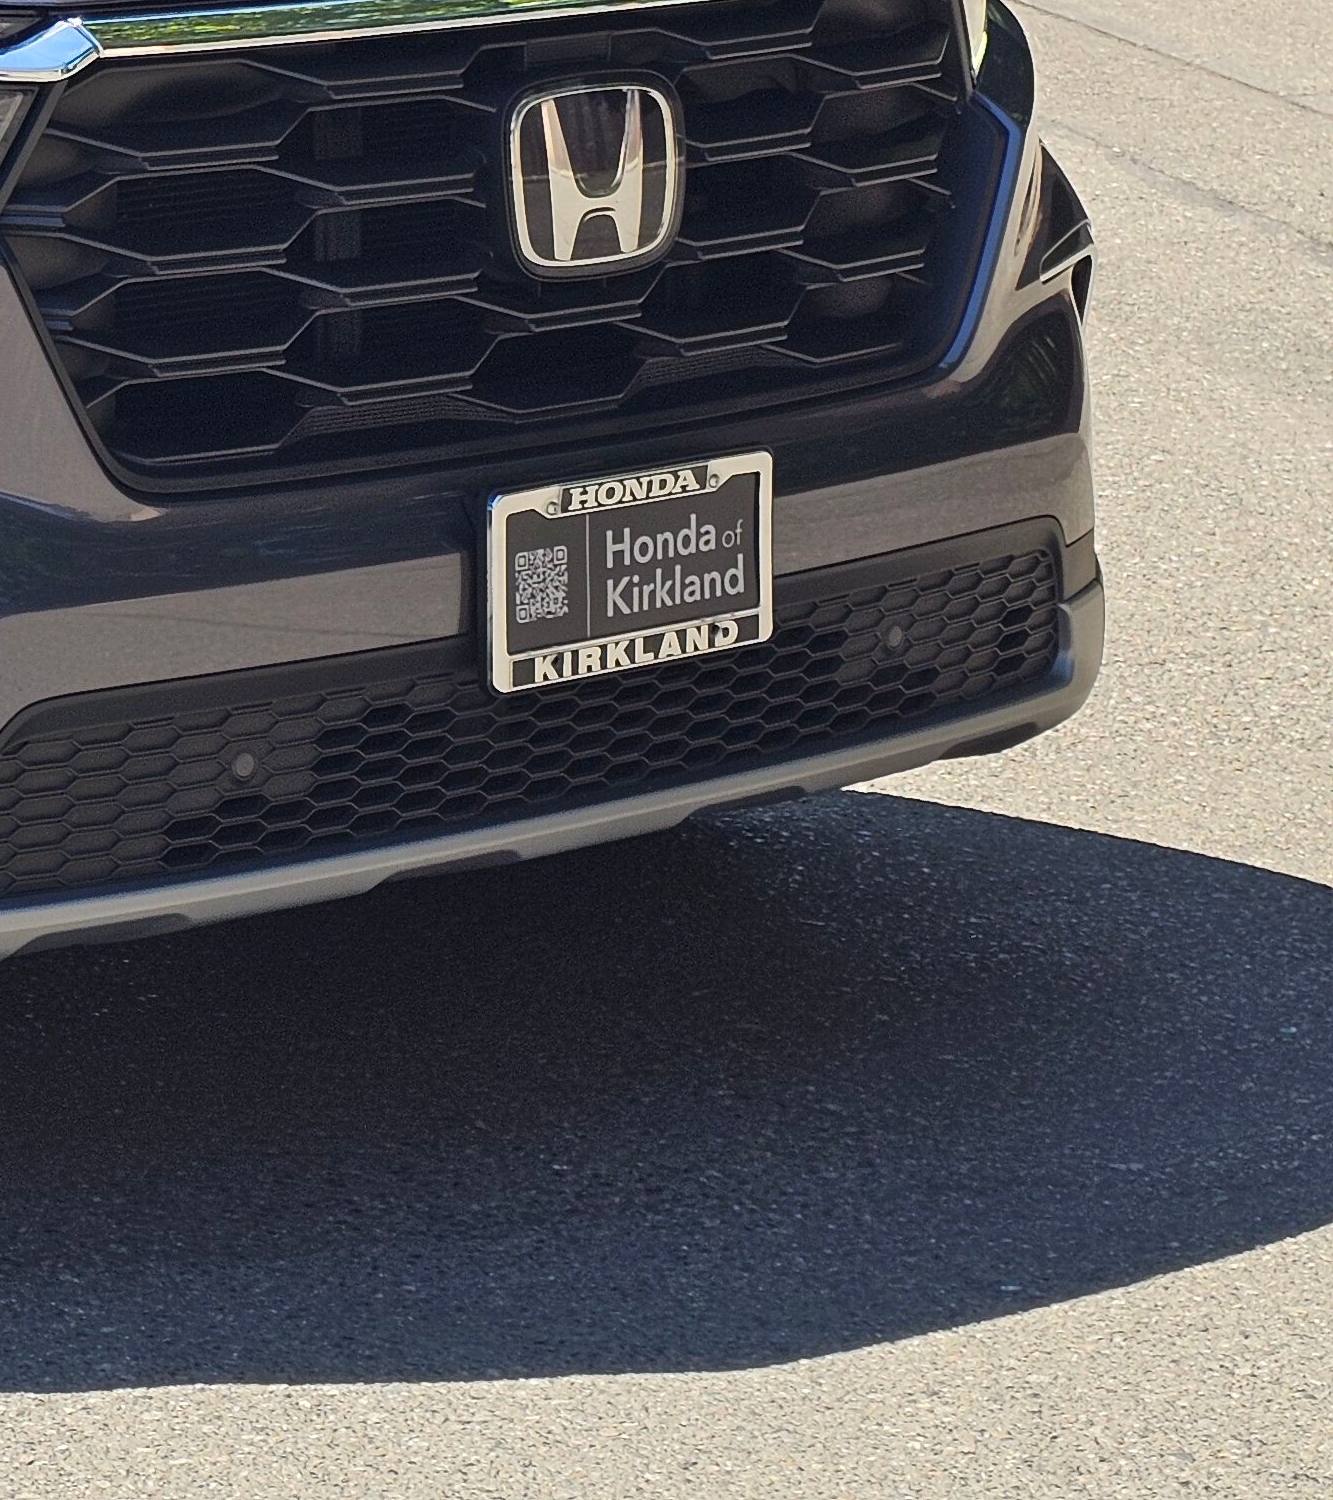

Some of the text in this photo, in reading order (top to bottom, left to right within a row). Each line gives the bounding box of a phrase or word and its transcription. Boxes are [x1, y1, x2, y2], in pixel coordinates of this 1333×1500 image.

[567, 468, 701, 512] HONDA
[606, 513, 743, 569] Honda of
[606, 553, 745, 617] Kirkland
[534, 619, 739, 683] KIRKLAND
